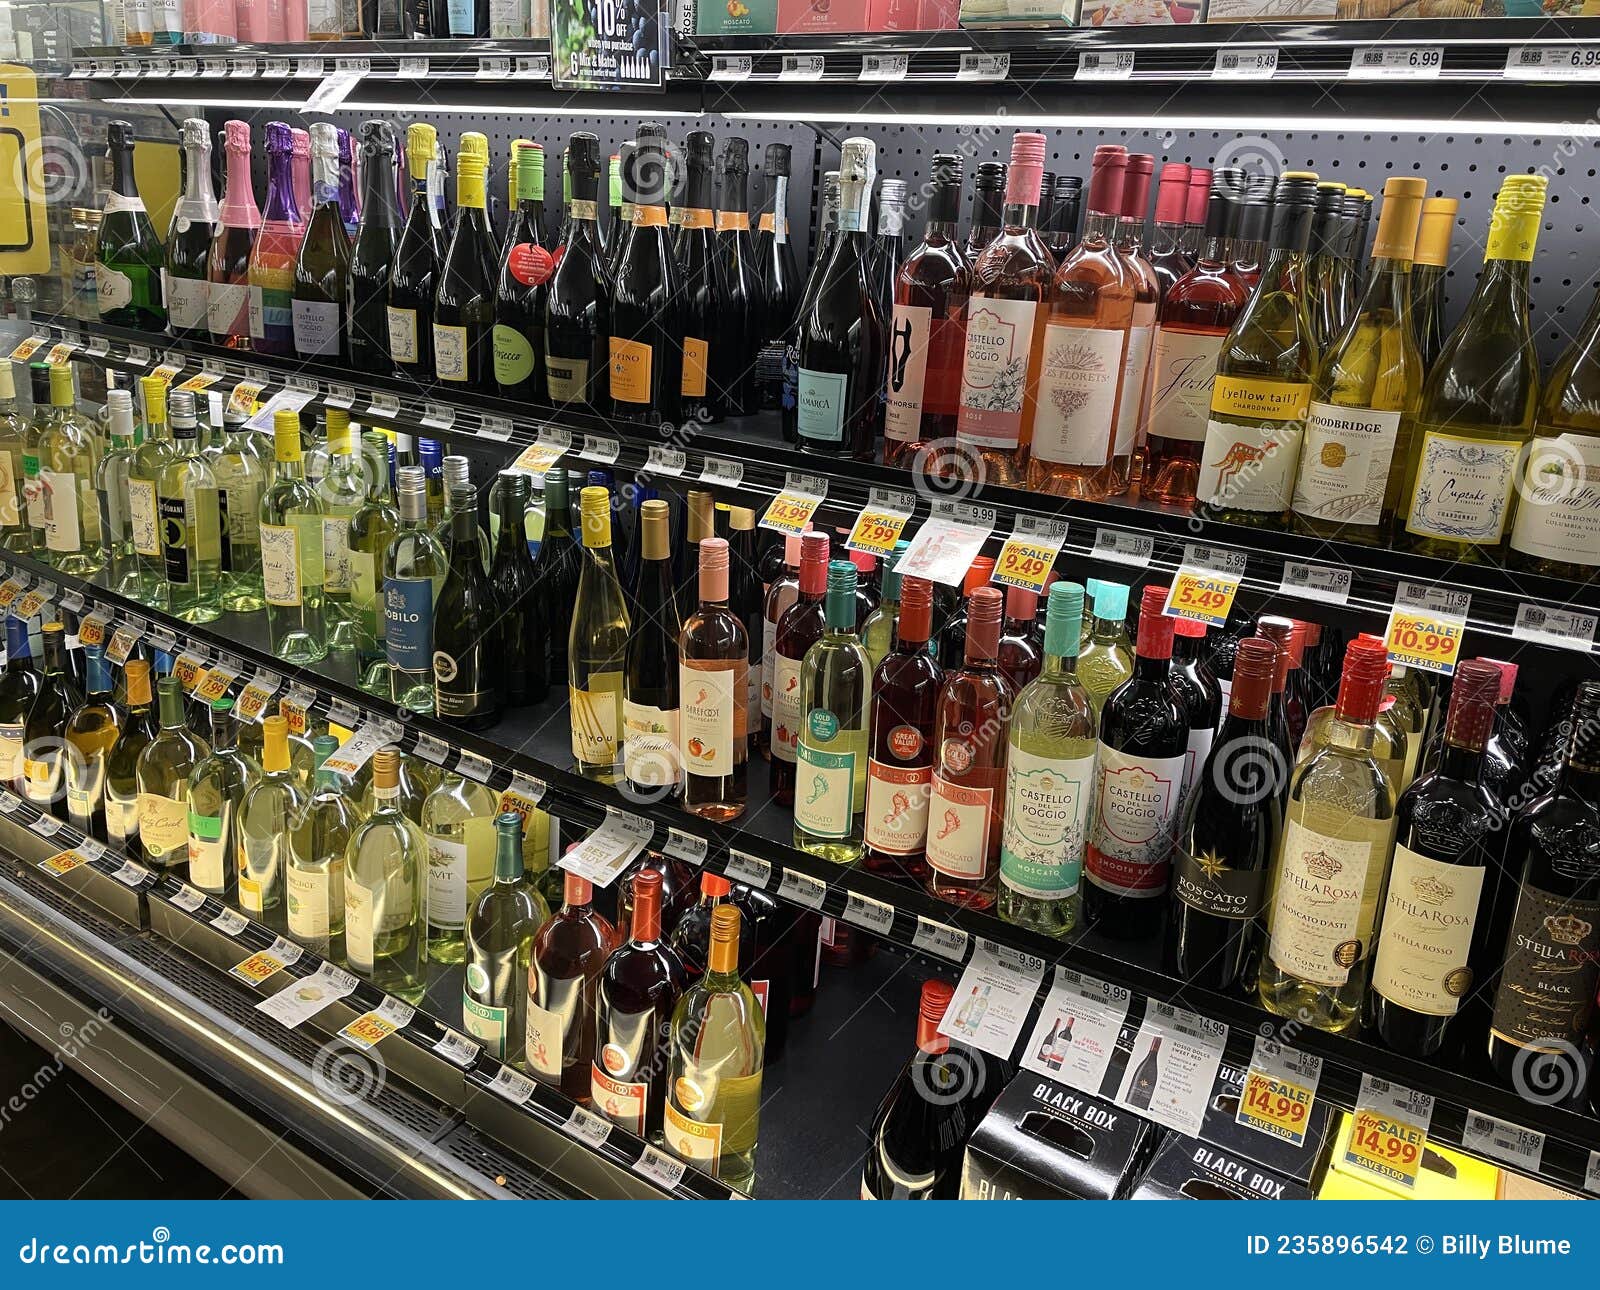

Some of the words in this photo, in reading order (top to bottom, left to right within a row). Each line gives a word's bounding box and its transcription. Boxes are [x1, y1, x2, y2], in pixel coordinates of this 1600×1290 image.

[616, 24, 627, 38] OFF
[602, 40, 611, 51] you
[611, 41, 634, 52] purchase
[570, 51, 579, 77] 6
[580, 54, 590, 68] Mix
[591, 56, 598, 69] &
[599, 55, 617, 70] Match
[738, 57, 750, 72] 7.99
[809, 57, 823, 71] 7.99
[993, 56, 1009, 70] 7.49
[1257, 54, 1276, 70] 9.49
[1409, 51, 1439, 67] 6.99
[1571, 51, 1600, 67] 6.99
[968, 333, 1005, 346] CASTELLO
[967, 352, 1000, 363] POGGIO
[894, 400, 919, 411] HORSE
[1233, 402, 1281, 413] CHARDONNAY
[1309, 415, 1382, 435] WOODBRIDGE
[1438, 478, 1489, 504] Cupcake
[900, 495, 915, 506] 8.99
[771, 504, 809, 521] 14.99
[972, 508, 994, 521] 9.99
[1437, 511, 1478, 522] CHARDONNAY
[874, 518, 904, 530] SALE!
[1545, 519, 1582, 531] COLUMBIA
[859, 524, 895, 543] 7.99
[1021, 547, 1053, 563] SALE!
[1226, 554, 1246, 567] 5.99
[1005, 554, 1045, 576] 9.49
[1000, 575, 1018, 585] SAVE
[1018, 579, 1035, 589] $1.50
[1329, 572, 1349, 586] 7.99
[1198, 580, 1236, 596] SALE!
[1179, 587, 1226, 609] 5.49
[1445, 591, 1469, 607] 11.99
[1178, 609, 1199, 619] SAVE
[1415, 621, 1460, 638] SALE!
[1569, 616, 1594, 632] 11.99
[82, 625, 100, 640] 7.99
[1391, 628, 1456, 655] 10.99
[1393, 653, 1418, 665] SAVE
[1418, 657, 1443, 669] $1.00
[202, 679, 224, 695] 7.99
[814, 712, 831, 722] GOLD
[589, 734, 614, 744] YOU
[895, 733, 916, 741] GREAT
[1021, 788, 1072, 804] CASTELLO
[1109, 785, 1162, 803] CASTELLO
[1111, 801, 1156, 818] POGGIO
[1127, 800, 1140, 808] DEL
[1022, 805, 1067, 820] POGGIO
[888, 831, 921, 840] MOSCATO
[1017, 863, 1060, 876] MOSCATO
[1179, 875, 1247, 905] ROSCATO
[1283, 867, 1320, 894] STELLA
[1322, 885, 1360, 901] ROSA
[1231, 904, 1248, 914] Red
[1282, 903, 1319, 924] MOSCATO
[1320, 920, 1347, 929] D'ASTI
[1389, 892, 1431, 921] STELLA
[1432, 910, 1470, 928] ROSA
[1392, 931, 1420, 949] STELLA
[1422, 943, 1453, 955] ROSSO
[1516, 934, 1566, 961] STELLA
[244, 957, 273, 976] 14.99
[1018, 953, 1043, 970] 9.99
[1294, 956, 1329, 971] CONTE
[1102, 983, 1128, 1001] 9.99
[1401, 983, 1438, 999] CONTE
[1538, 982, 1571, 994] BLACK
[351, 1019, 385, 1041] 14.99
[1198, 1016, 1226, 1036] 14.99
[1531, 1027, 1568, 1039] CONTE
[1270, 1083, 1310, 1105] SALE!
[1408, 1089, 1432, 1107] 15.99
[1032, 1083, 1084, 1116] BLACK
[1083, 1105, 1118, 1132] BOX
[1248, 1088, 1305, 1122] 14.99
[1247, 1116, 1271, 1132] SAVE
[1270, 1125, 1293, 1139] $1.00
[1380, 1120, 1422, 1146] SALE!
[1355, 1125, 1418, 1164] 14.99
[1518, 1130, 1541, 1150] 15.99
[1192, 1147, 1248, 1182] BLACK
[1249, 1173, 1286, 1200] BOX
[1355, 1155, 1380, 1173] SAVE
[1379, 1165, 1405, 1181] $1.00
